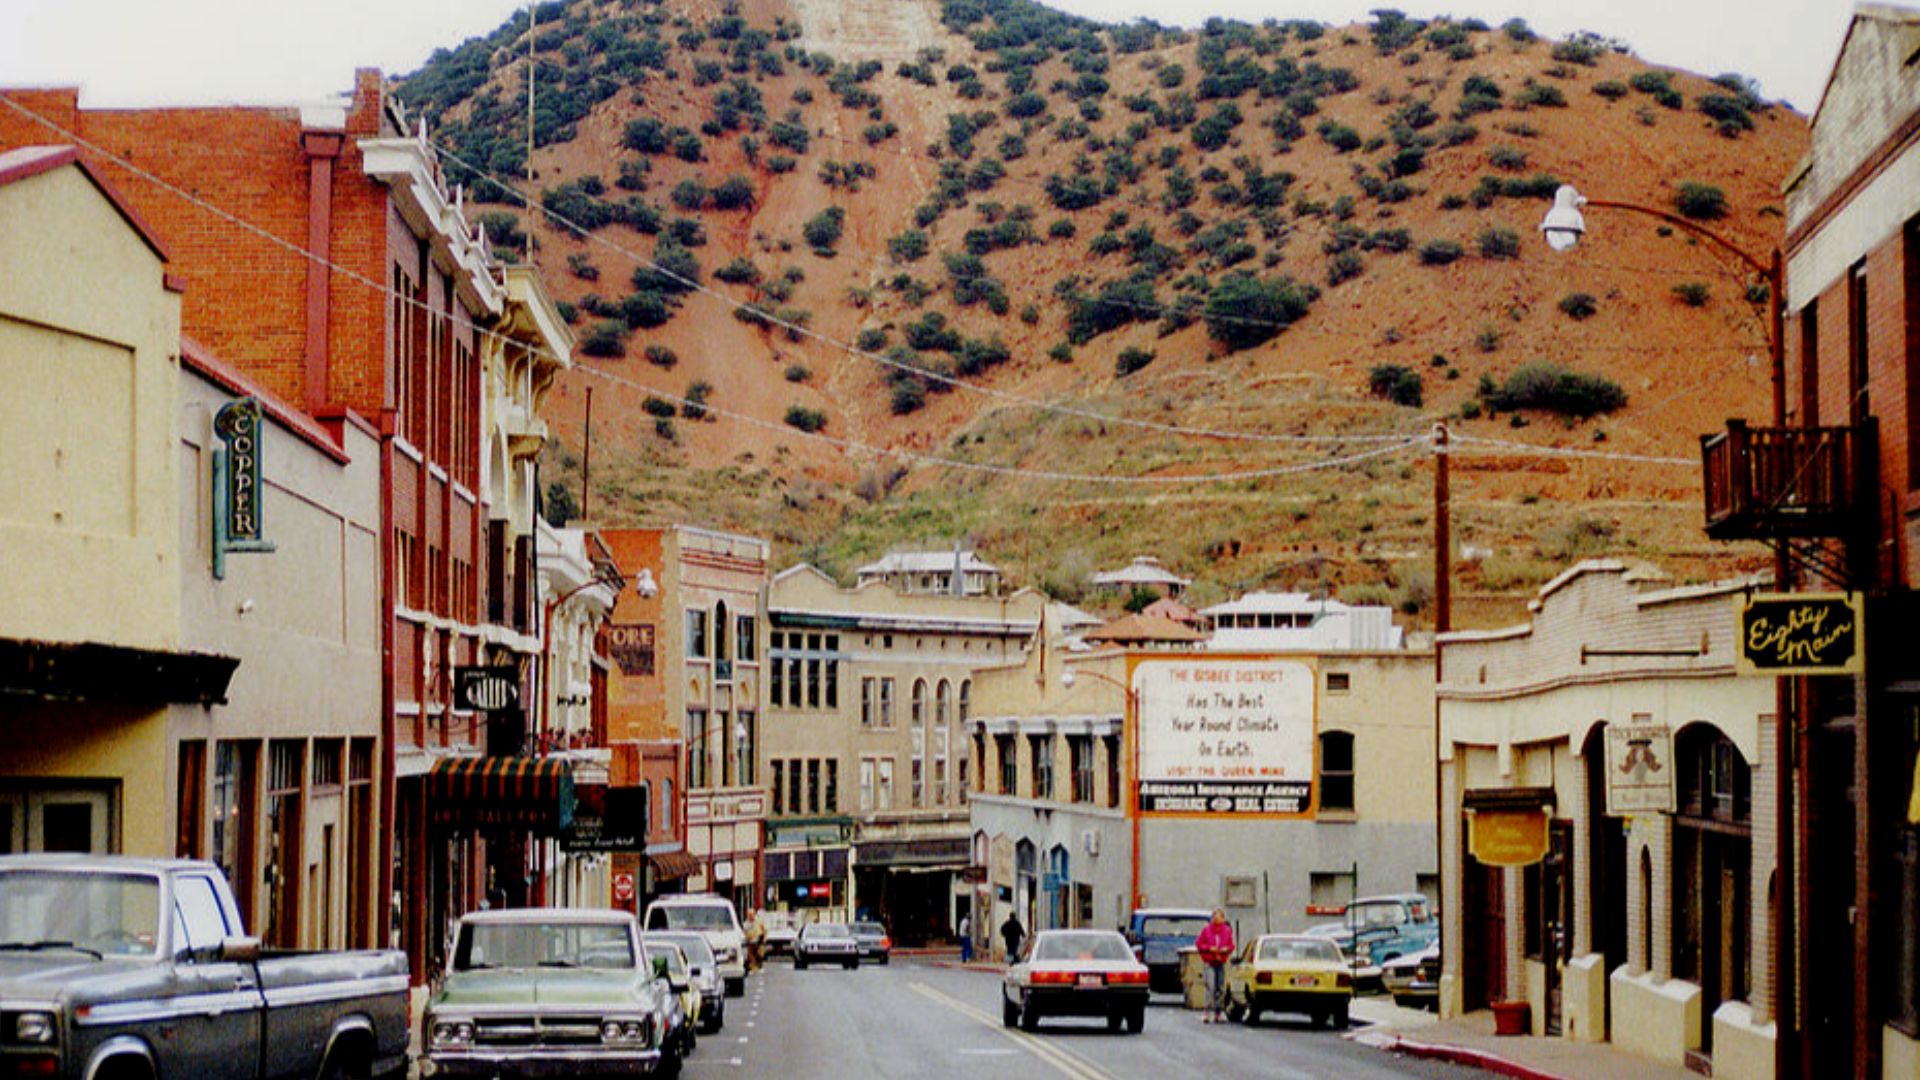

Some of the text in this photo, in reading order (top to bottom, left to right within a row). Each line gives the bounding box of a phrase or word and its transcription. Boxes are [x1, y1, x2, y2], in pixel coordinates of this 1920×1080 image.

[234, 416, 256, 534] COPPER
[1748, 605, 1829, 651] Eighty
[1777, 621, 1852, 664] Main
[1169, 669, 1188, 682] THE
[1235, 669, 1283, 682] DISTRICT
[1186, 692, 1264, 708] Has The Best
[1171, 715, 1279, 731] Year Round Climate
[1199, 740, 1212, 756] On
[1166, 766, 1285, 777] VISIT THE QUEEN MINE
